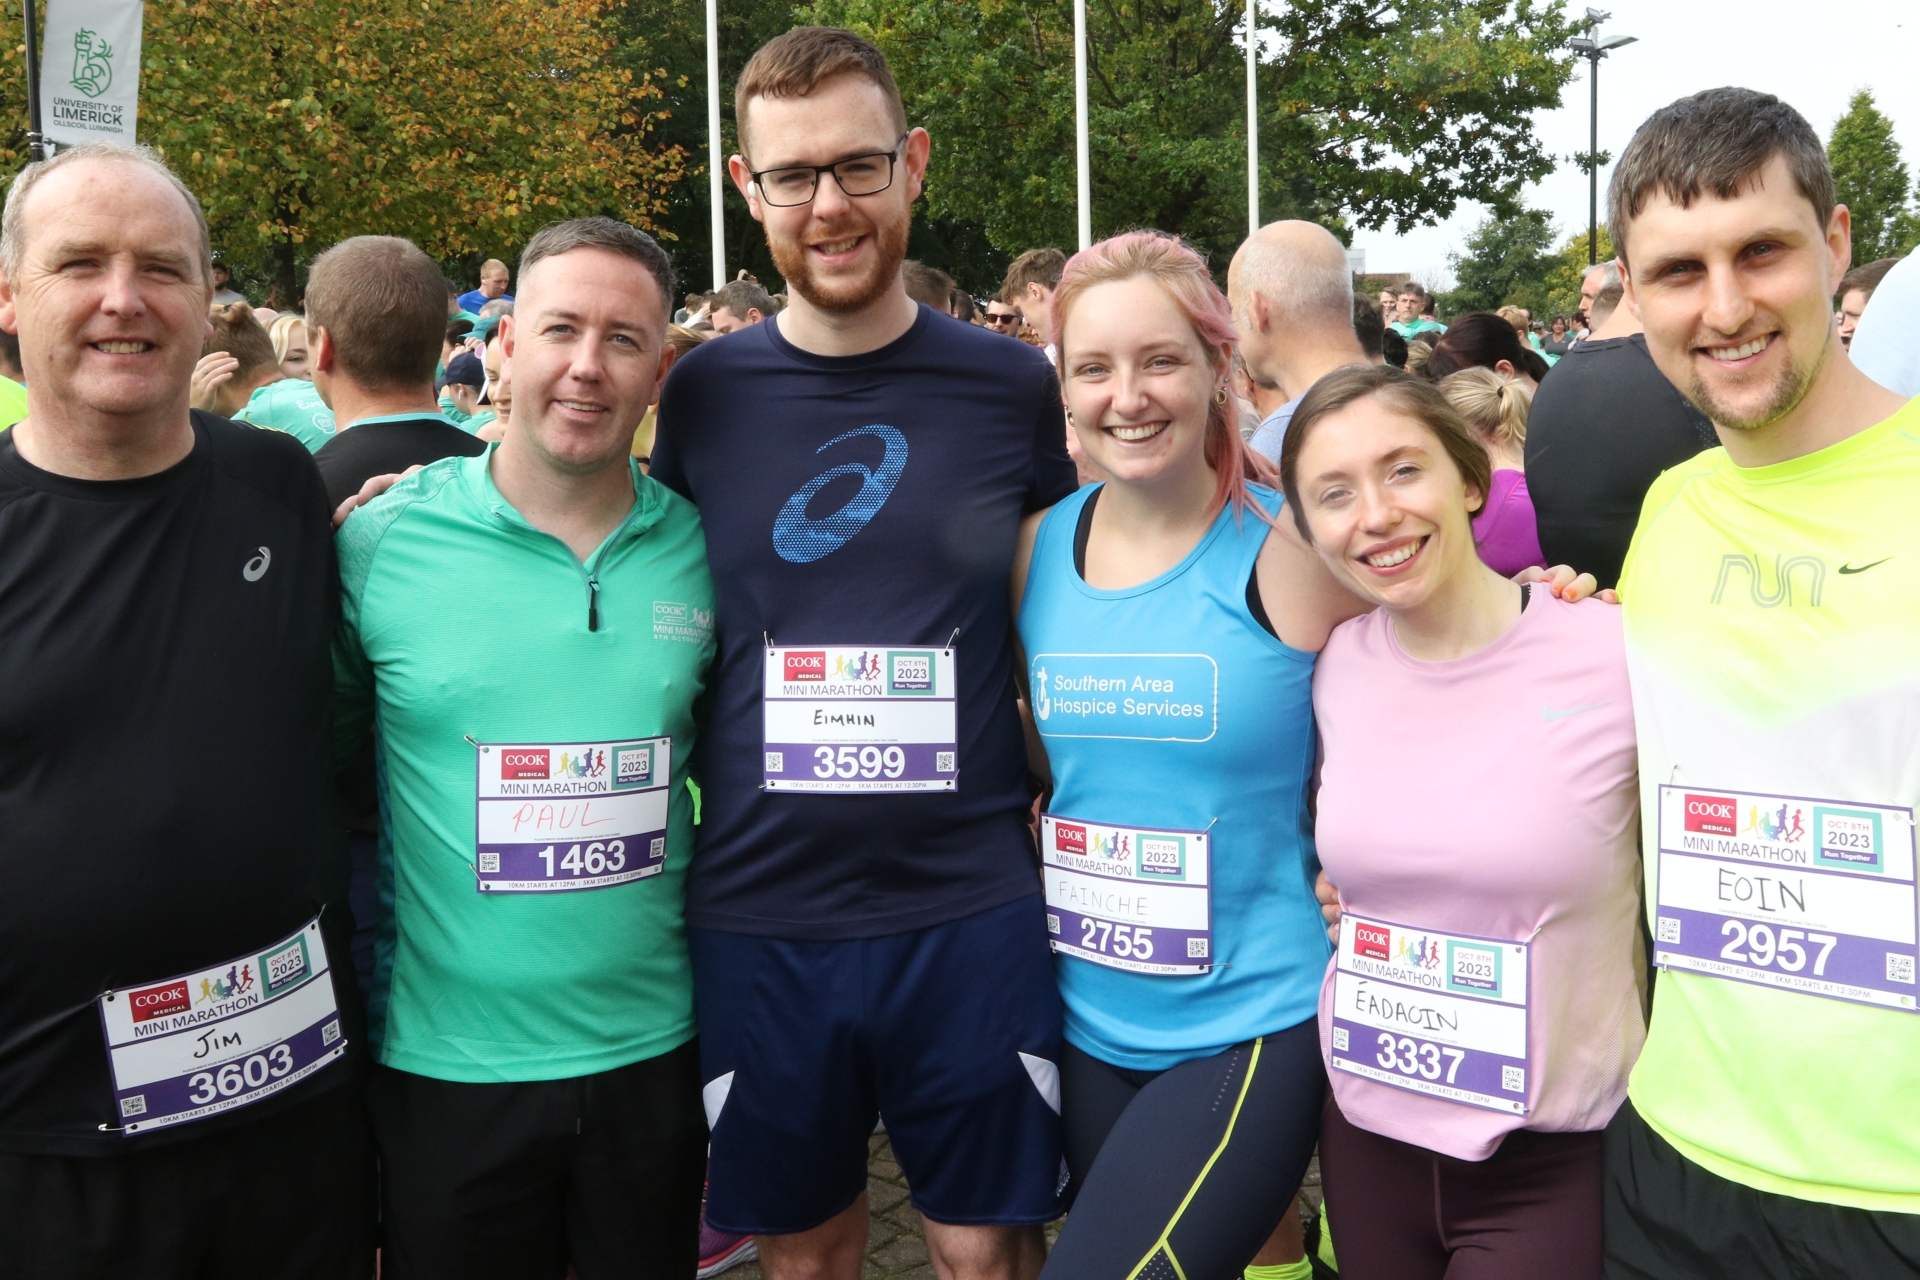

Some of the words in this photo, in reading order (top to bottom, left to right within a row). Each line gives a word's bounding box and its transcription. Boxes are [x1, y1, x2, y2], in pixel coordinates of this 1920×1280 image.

[54, 97, 109, 111] UNIVERSITY
[111, 105, 123, 113] OF
[53, 106, 123, 126] LIMERICK
[53, 120, 87, 129] OLLSCOIL
[89, 124, 123, 133] LUIMNIGH
[1710, 554, 1826, 608] run
[655, 606, 682, 615] COOK
[654, 625, 673, 634] MINI
[787, 657, 821, 667] COOK
[897, 669, 927, 679] 2023
[783, 685, 807, 695] MINI
[811, 685, 882, 695] MARATHON
[1054, 675, 1126, 691] Southern
[1131, 676, 1174, 693] Area
[1053, 697, 1116, 717] Hospice
[1123, 698, 1203, 717] Services
[813, 709, 874, 727] EIMHIN
[506, 754, 545, 766] COOK
[636, 752, 647, 760] 8TH
[813, 746, 905, 778] 3599
[621, 761, 647, 773] 2023
[501, 784, 529, 794] MINI
[533, 781, 606, 794] MARATHON
[512, 802, 616, 832] PAUL
[1688, 802, 1732, 818] COOK
[1702, 825, 1732, 833] MEDICAL
[1828, 820, 1848, 829] OCT
[1851, 823, 1869, 831] 8TH
[1058, 828, 1083, 842] COOK
[1828, 832, 1870, 848] 2023
[1066, 845, 1084, 853] MEDICAL
[1146, 852, 1177, 864] 2023
[1684, 836, 1713, 851] MINI
[1718, 842, 1806, 864] MARATHON
[1840, 852, 1871, 862] Together
[538, 840, 625, 877] 1463
[1056, 854, 1074, 866] MINI
[1076, 856, 1131, 876] MARATHON
[597, 876, 615, 884] STARTS
[616, 874, 622, 882] AT
[623, 871, 642, 880] 12:30PM
[1059, 881, 1148, 916] FAINCHE
[1719, 867, 1805, 912] EOIN
[1081, 917, 1153, 960] 2755
[1357, 929, 1387, 945] COOK
[271, 955, 285, 966] OCT
[287, 947, 299, 959] 8TH
[1365, 949, 1386, 958] MEDICAL
[1720, 920, 1837, 976] 2957
[1065, 945, 1076, 953] 10KM
[1076, 949, 1090, 958] STARTS
[1096, 953, 1107, 962] 12PM
[1124, 961, 1142, 970] STARTS
[1458, 952, 1474, 960] OCT
[1476, 954, 1492, 963] 8TH
[272, 955, 301, 979] 2023
[1352, 958, 1374, 973] MINI
[1376, 964, 1442, 988] MARATHON
[1458, 961, 1491, 977] 2023
[272, 979, 283, 989] Run
[283, 969, 303, 985] Together
[1467, 979, 1492, 988] Together
[1688, 959, 1708, 970] 10KM
[1709, 962, 1734, 974] STARTS
[1735, 968, 1744, 976] AT
[1746, 969, 1765, 980] 12PM
[1775, 975, 1792, 986] 5KM
[1794, 978, 1821, 991] STARTS
[1823, 982, 1835, 992] AT
[1836, 985, 1871, 999] 12:30PM
[135, 987, 183, 1008] COOK
[1356, 981, 1458, 1031] ÉADAOIN
[134, 1020, 169, 1038] MINI
[173, 993, 258, 1028] MARATHON
[153, 1004, 186, 1016] MEDICAL
[193, 1029, 242, 1058] JIM
[1376, 1032, 1465, 1084] 3337
[189, 1044, 293, 1105] 3603
[159, 1112, 179, 1124] 10KM
[181, 1108, 206, 1120] STARTS
[208, 1104, 216, 1114] AT
[219, 1099, 237, 1110] 12PM
[246, 1091, 261, 1102] 5KM
[262, 1080, 283, 1096] STARTS
[285, 1075, 293, 1085] AT
[294, 1063, 318, 1082] 12:30PM
[1354, 1065, 1367, 1074] 10KM
[1369, 1068, 1386, 1079] STARTS
[1395, 1076, 1410, 1086] 12PM
[1417, 1082, 1430, 1091] 5KM
[1432, 1085, 1453, 1096] STARTS
[1464, 1092, 1490, 1104] 12:30PM
